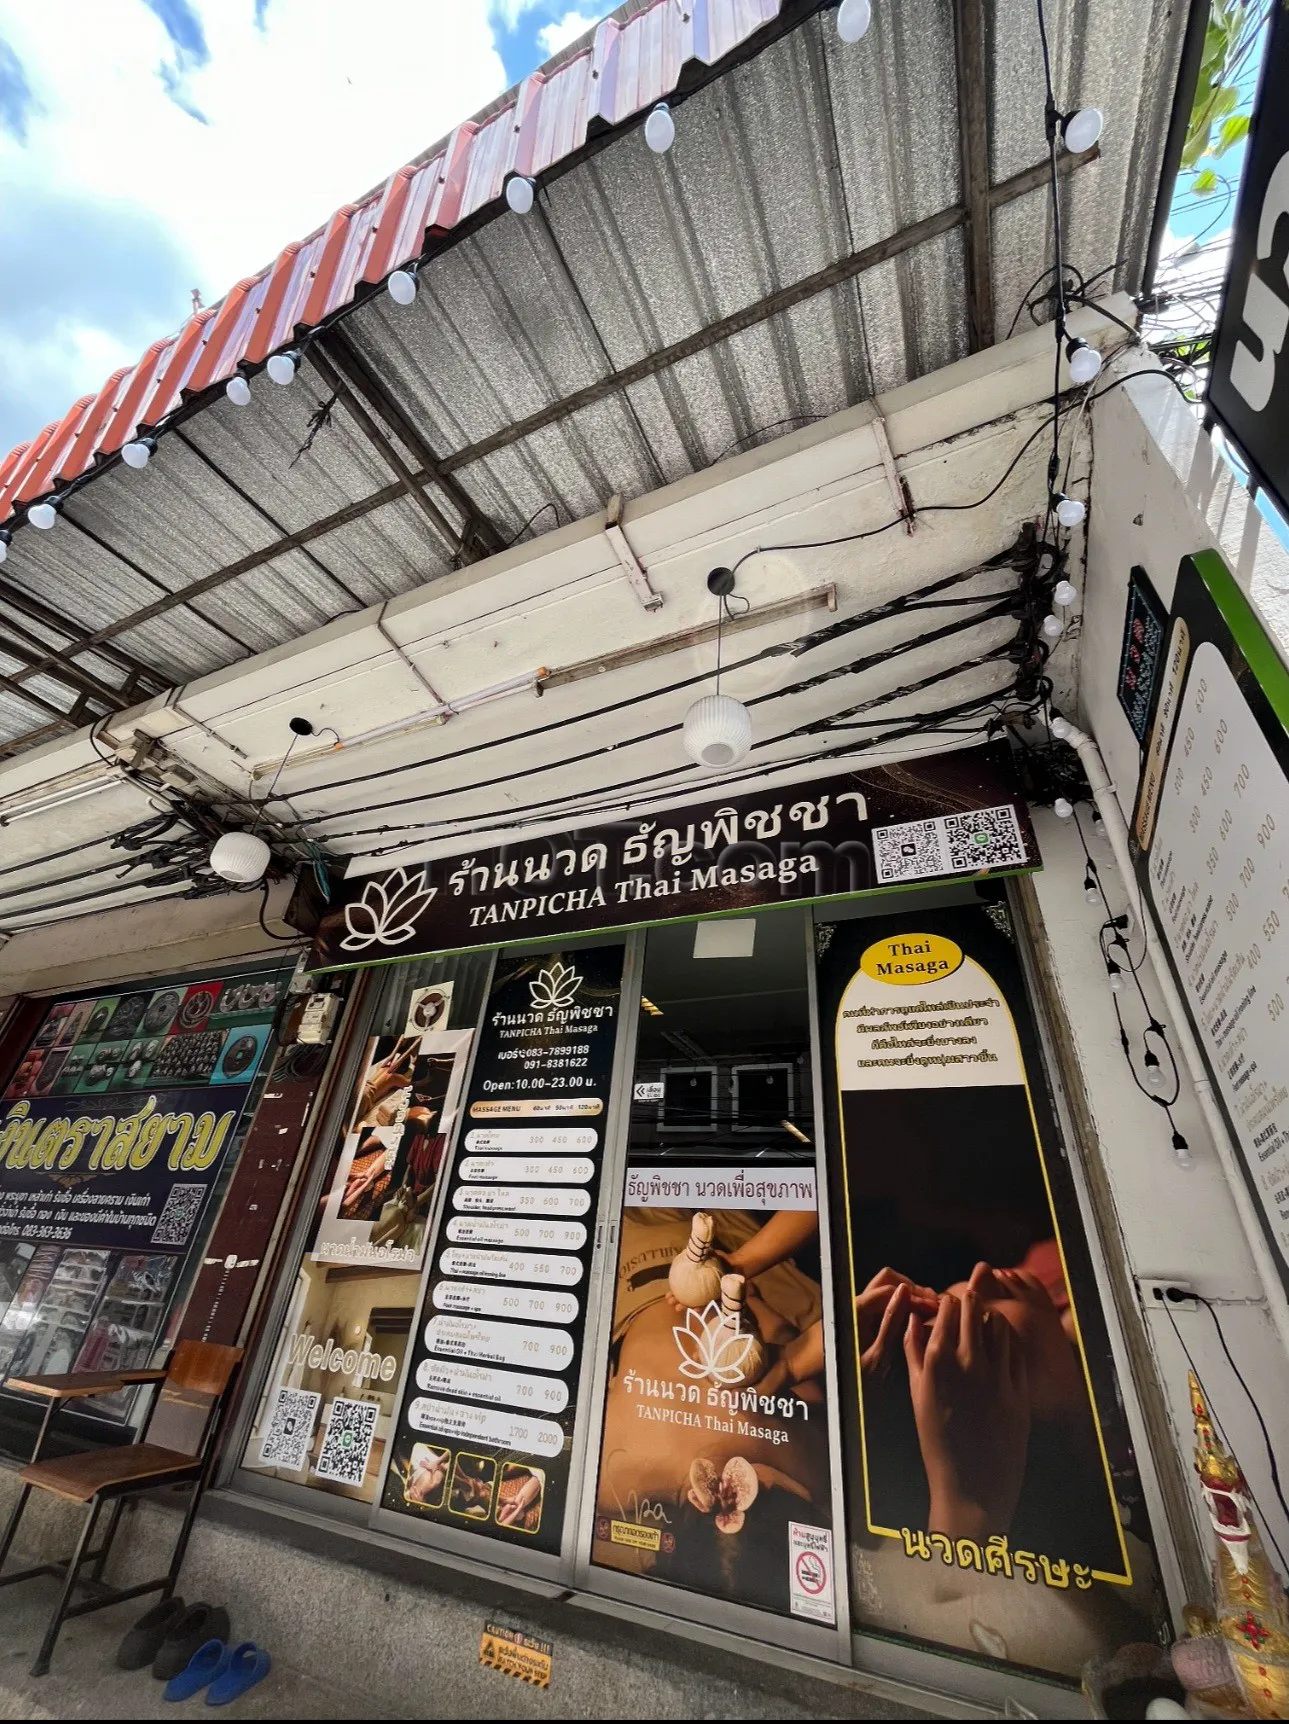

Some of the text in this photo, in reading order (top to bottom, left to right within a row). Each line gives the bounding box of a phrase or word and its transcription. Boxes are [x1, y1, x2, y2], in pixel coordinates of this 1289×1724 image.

[1206, 763, 1250, 875] 350 600 700
[449, 789, 869, 896] ร้านนวด ธัญพิชชา
[1226, 813, 1276, 921] 500 700 900
[470, 850, 820, 927] TANPICHA Thai Masaga
[888, 940, 932, 957] Thai
[876, 959, 949, 976] Masaga
[1267, 993, 1285, 1022] 500
[492, 1006, 614, 1027] ร้านนวด ธัญพิชชา
[500, 1024, 598, 1039] TANPICHA Thai Masaga
[526, 1045, 590, 1057] 083-7899188
[524, 1058, 588, 1069] 091-8381622
[529, 1136, 593, 1144] 300 450 600
[524, 1166, 589, 1175] 300 450 600
[628, 1169, 813, 1206] ธัญพิชชา นวดเพื่อสุขภาพ
[519, 1196, 585, 1207] 350 600 700
[514, 1228, 581, 1241] 500 700 900
[509, 1262, 577, 1276] 400 550 700
[502, 1297, 573, 1313] 500 700 900
[522, 1341, 568, 1356] 700 900
[288, 1333, 398, 1383] Welcome
[516, 1385, 562, 1401] 700 900
[623, 1369, 809, 1421] ร้านนวด ธัญพิชชา
[637, 1404, 789, 1445] TANPICHA Thai Masaga
[509, 1426, 558, 1445] 1700 2000
[902, 1527, 1093, 1590] นวดศีรษะ
